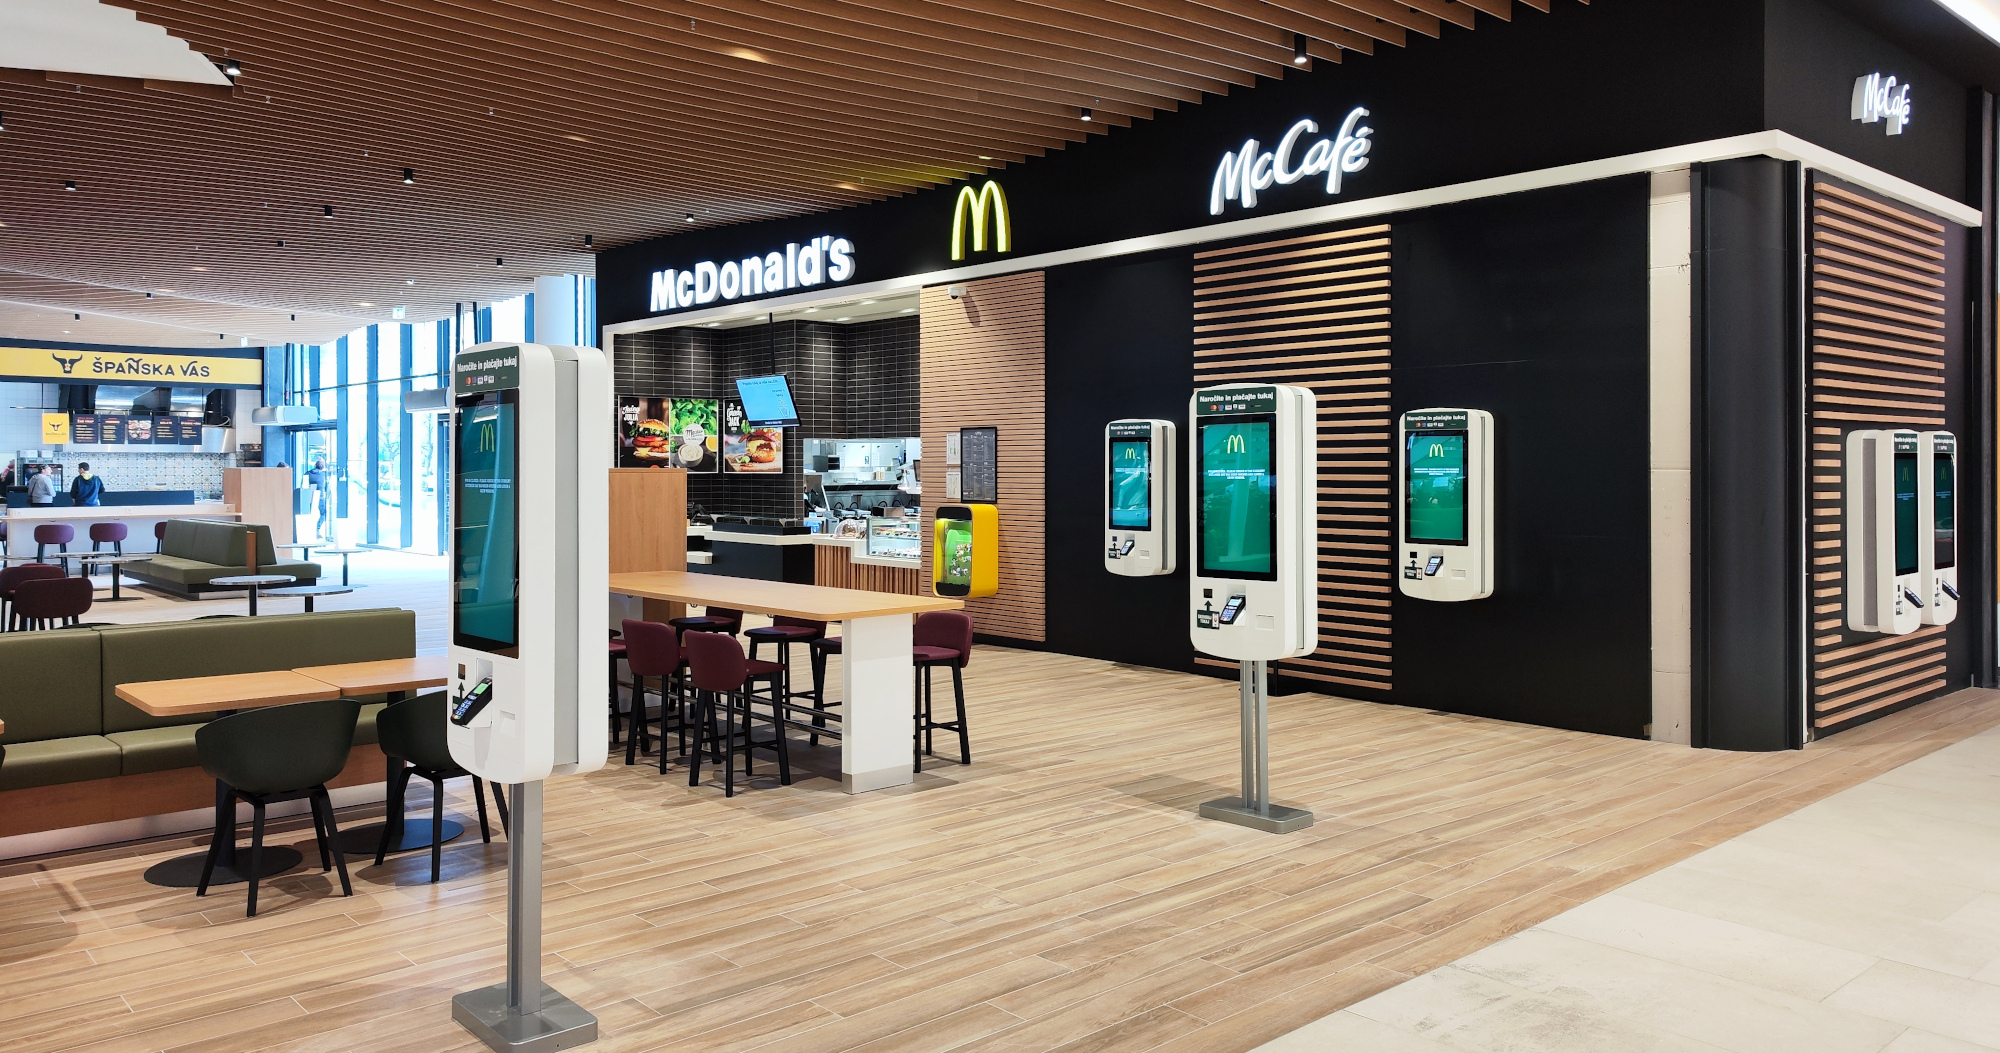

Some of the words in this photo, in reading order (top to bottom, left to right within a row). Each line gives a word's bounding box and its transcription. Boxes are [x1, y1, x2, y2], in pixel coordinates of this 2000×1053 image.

[1851, 72, 1911, 136] McCafé
[1210, 107, 1374, 216] McCafé
[650, 235, 856, 313] McDonald's
[457, 361, 477, 373] Naročite
[478, 360, 483, 370] in
[483, 358, 503, 371] plačajte
[503, 355, 518, 367] tukaj
[1200, 395, 1224, 403] Naročite
[1232, 393, 1256, 402] plačajte
[1257, 392, 1273, 401] tukaj
